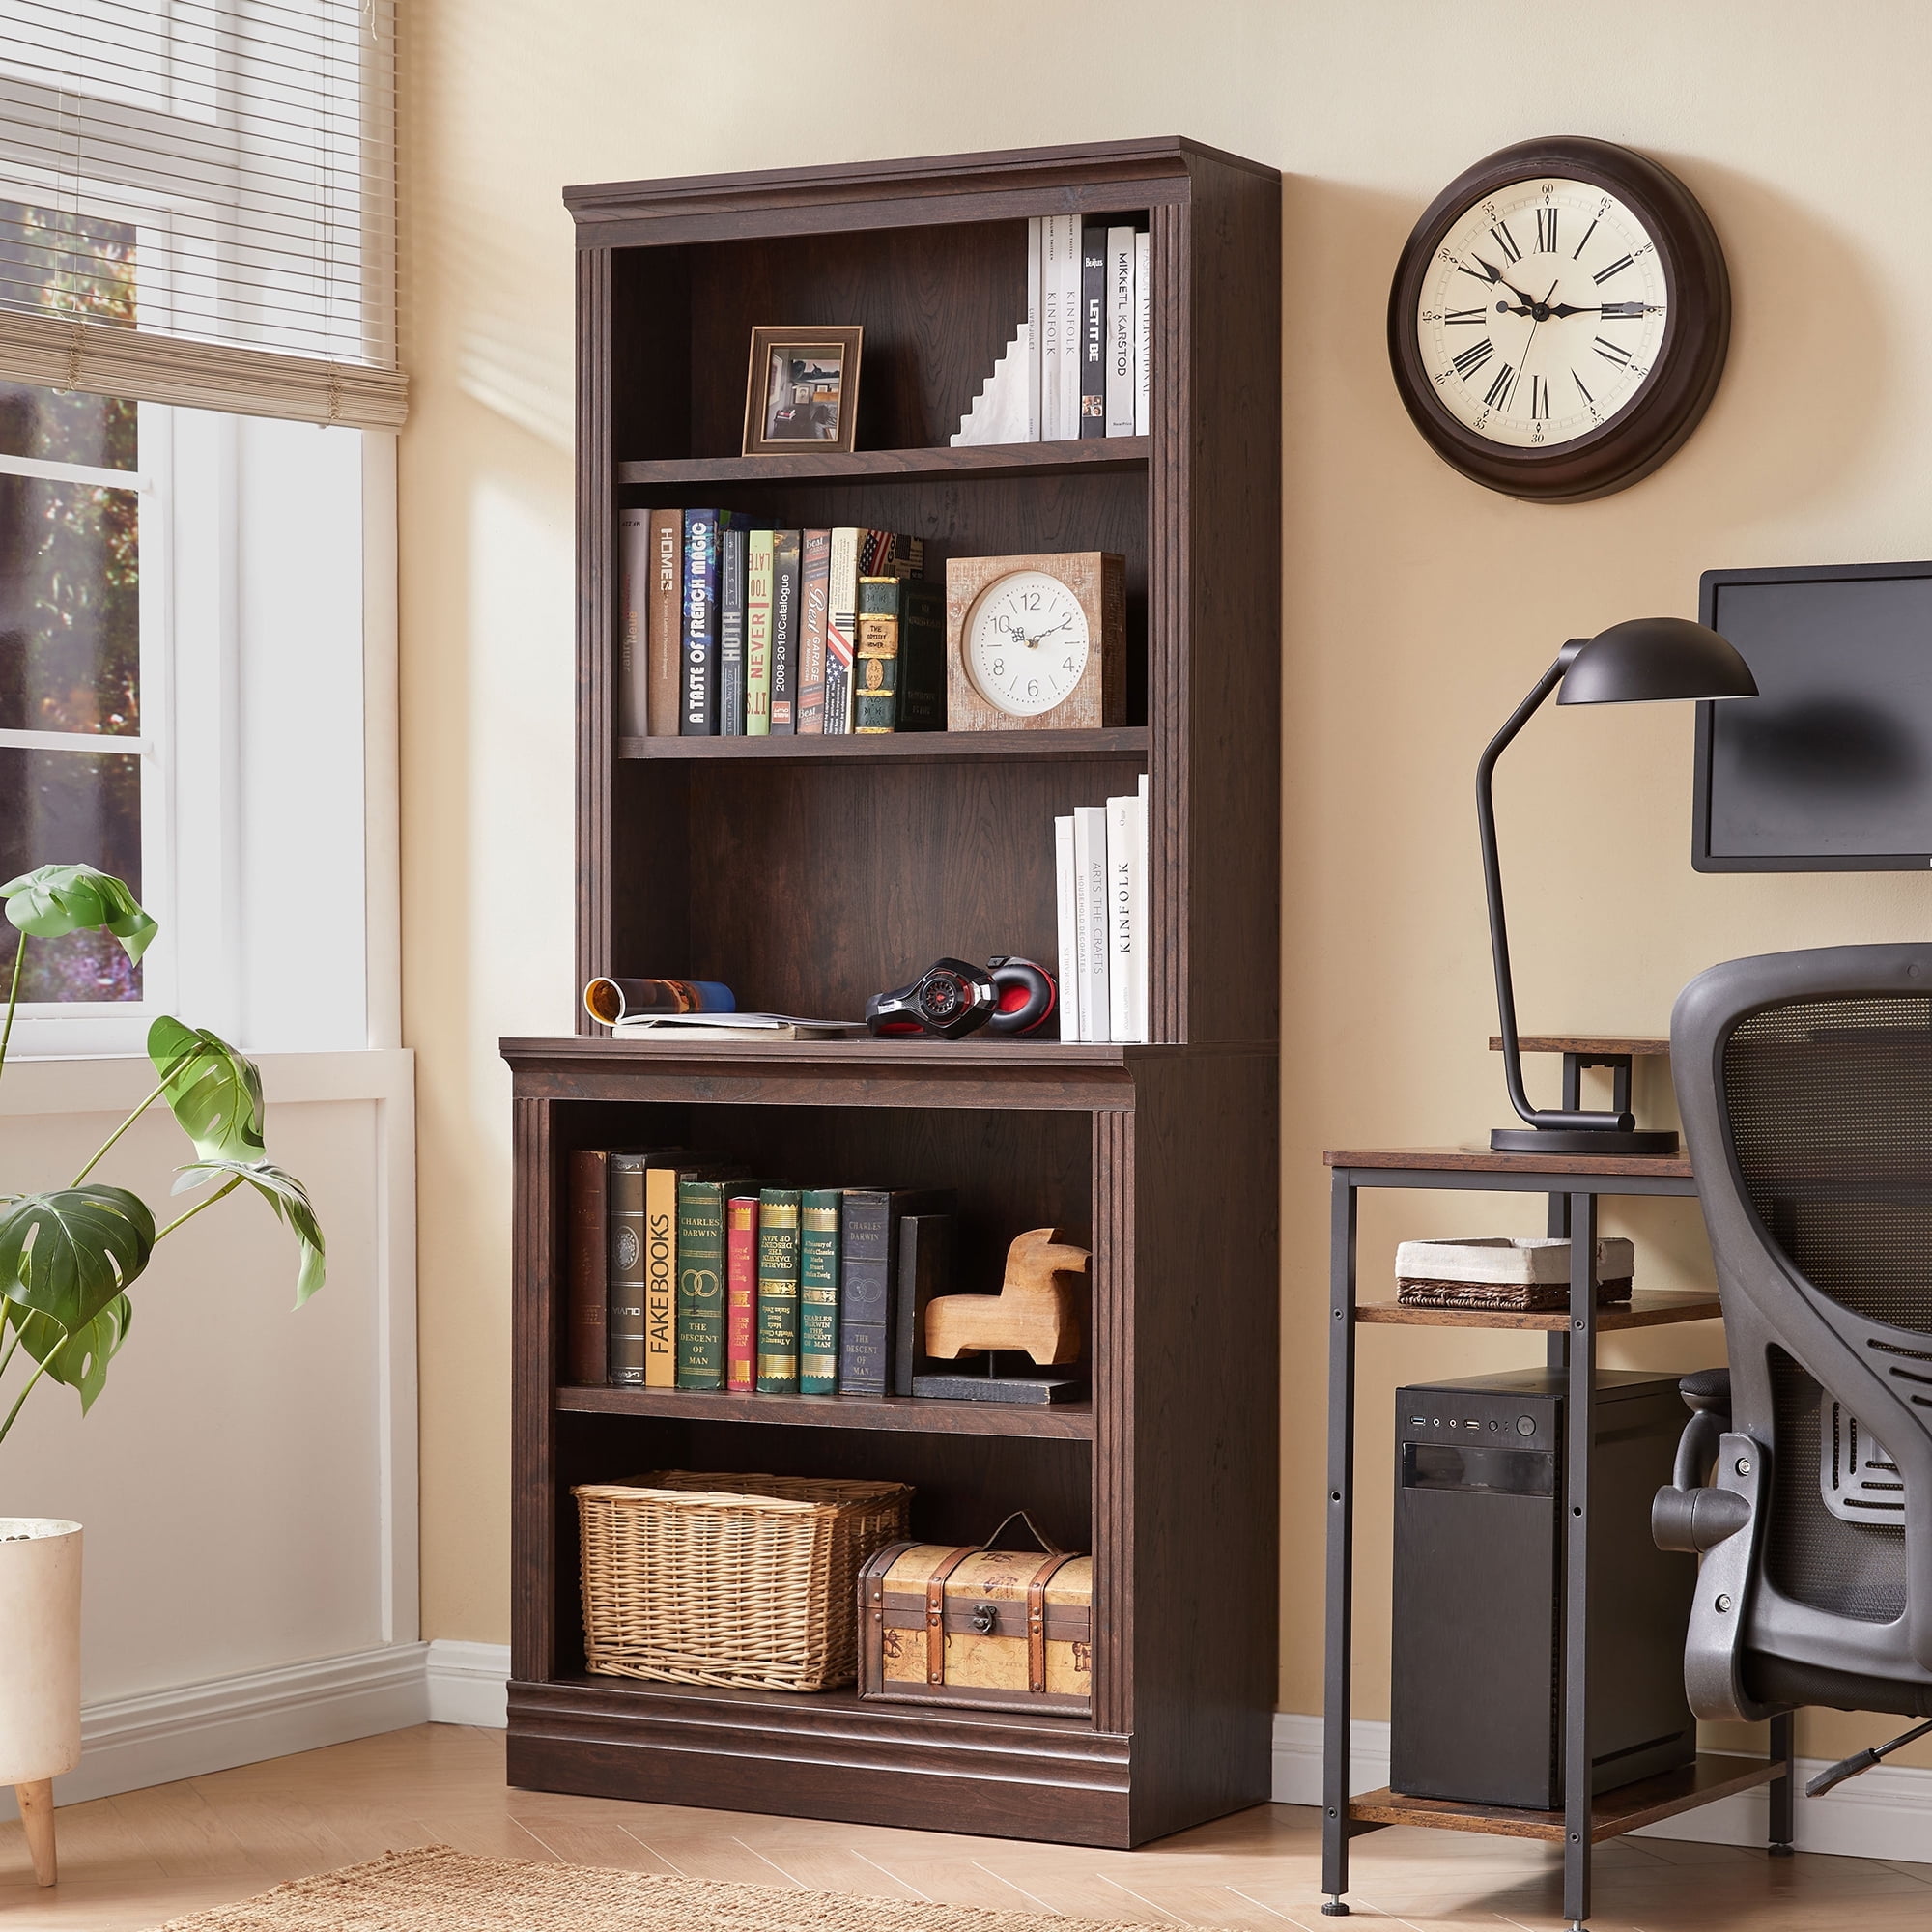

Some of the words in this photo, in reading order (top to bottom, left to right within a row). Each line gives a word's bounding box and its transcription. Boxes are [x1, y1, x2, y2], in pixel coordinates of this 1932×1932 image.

[1541, 184, 1553, 194] 60
[1481, 201, 1495, 215] 55
[1600, 196, 1613, 210] 05
[1532, 208, 1559, 254] XII
[1489, 220, 1523, 270] XI
[1643, 242, 1654, 253] 10
[1438, 248, 1451, 263] 50
[1592, 253, 1635, 286] II
[1118, 252, 1128, 310] MIKKETL
[1089, 299, 1099, 326] LET
[1422, 310, 1432, 323] 45
[1444, 305, 1487, 326] IX
[1046, 292, 1056, 355] KINFOLK
[1066, 291, 1075, 355] KINFOLK
[1089, 327, 1099, 340] IT
[1089, 343, 1099, 363] BE
[1117, 314, 1127, 377] KARSTOD
[1434, 372, 1446, 386] 40
[1473, 417, 1486, 429] 35
[1531, 434, 1544, 443] 30
[691, 522, 707, 575] MAGIC
[660, 527, 673, 591] HOMES
[749, 553, 770, 571] LATE
[751, 579, 767, 597] TOO
[690, 579, 706, 638] FRENCH
[807, 583, 826, 634] Best
[1020, 592, 1041, 611] 12
[626, 611, 638, 643] Neue
[990, 615, 1010, 634] 10
[1061, 611, 1073, 631] 2
[722, 611, 741, 661] HOTH
[776, 574, 791, 692] 2008-2018/Catalogue
[690, 640, 705, 664] OF
[750, 612, 766, 679] NEVER
[811, 636, 821, 682] GARAGE
[993, 658, 1005, 676] 8
[1062, 656, 1075, 672] 4
[689, 666, 705, 709] TASTE
[1027, 679, 1039, 697] 6
[689, 712, 704, 724] A
[1092, 861, 1101, 893] ARTS
[1093, 899, 1103, 923] THE
[1118, 862, 1131, 953] KINFOLK
[1093, 928, 1104, 975] CRAFTS
[681, 1217, 720, 1227] CHARLES
[848, 1221, 881, 1231] CHARLES
[682, 1229, 718, 1237] DARWIN
[850, 1233, 880, 1242] DARWIN
[650, 1213, 669, 1293] BOOKS
[650, 1297, 669, 1354] FAKE
[688, 1322, 707, 1331] THE
[680, 1334, 719, 1343] DESCENT
[855, 1334, 869, 1344] THE
[693, 1346, 705, 1354] OF
[846, 1345, 878, 1354] DESCENT
[689, 1357, 709, 1366] MAN
[856, 1355, 867, 1364] OF
[852, 1366, 870, 1376] MAN
